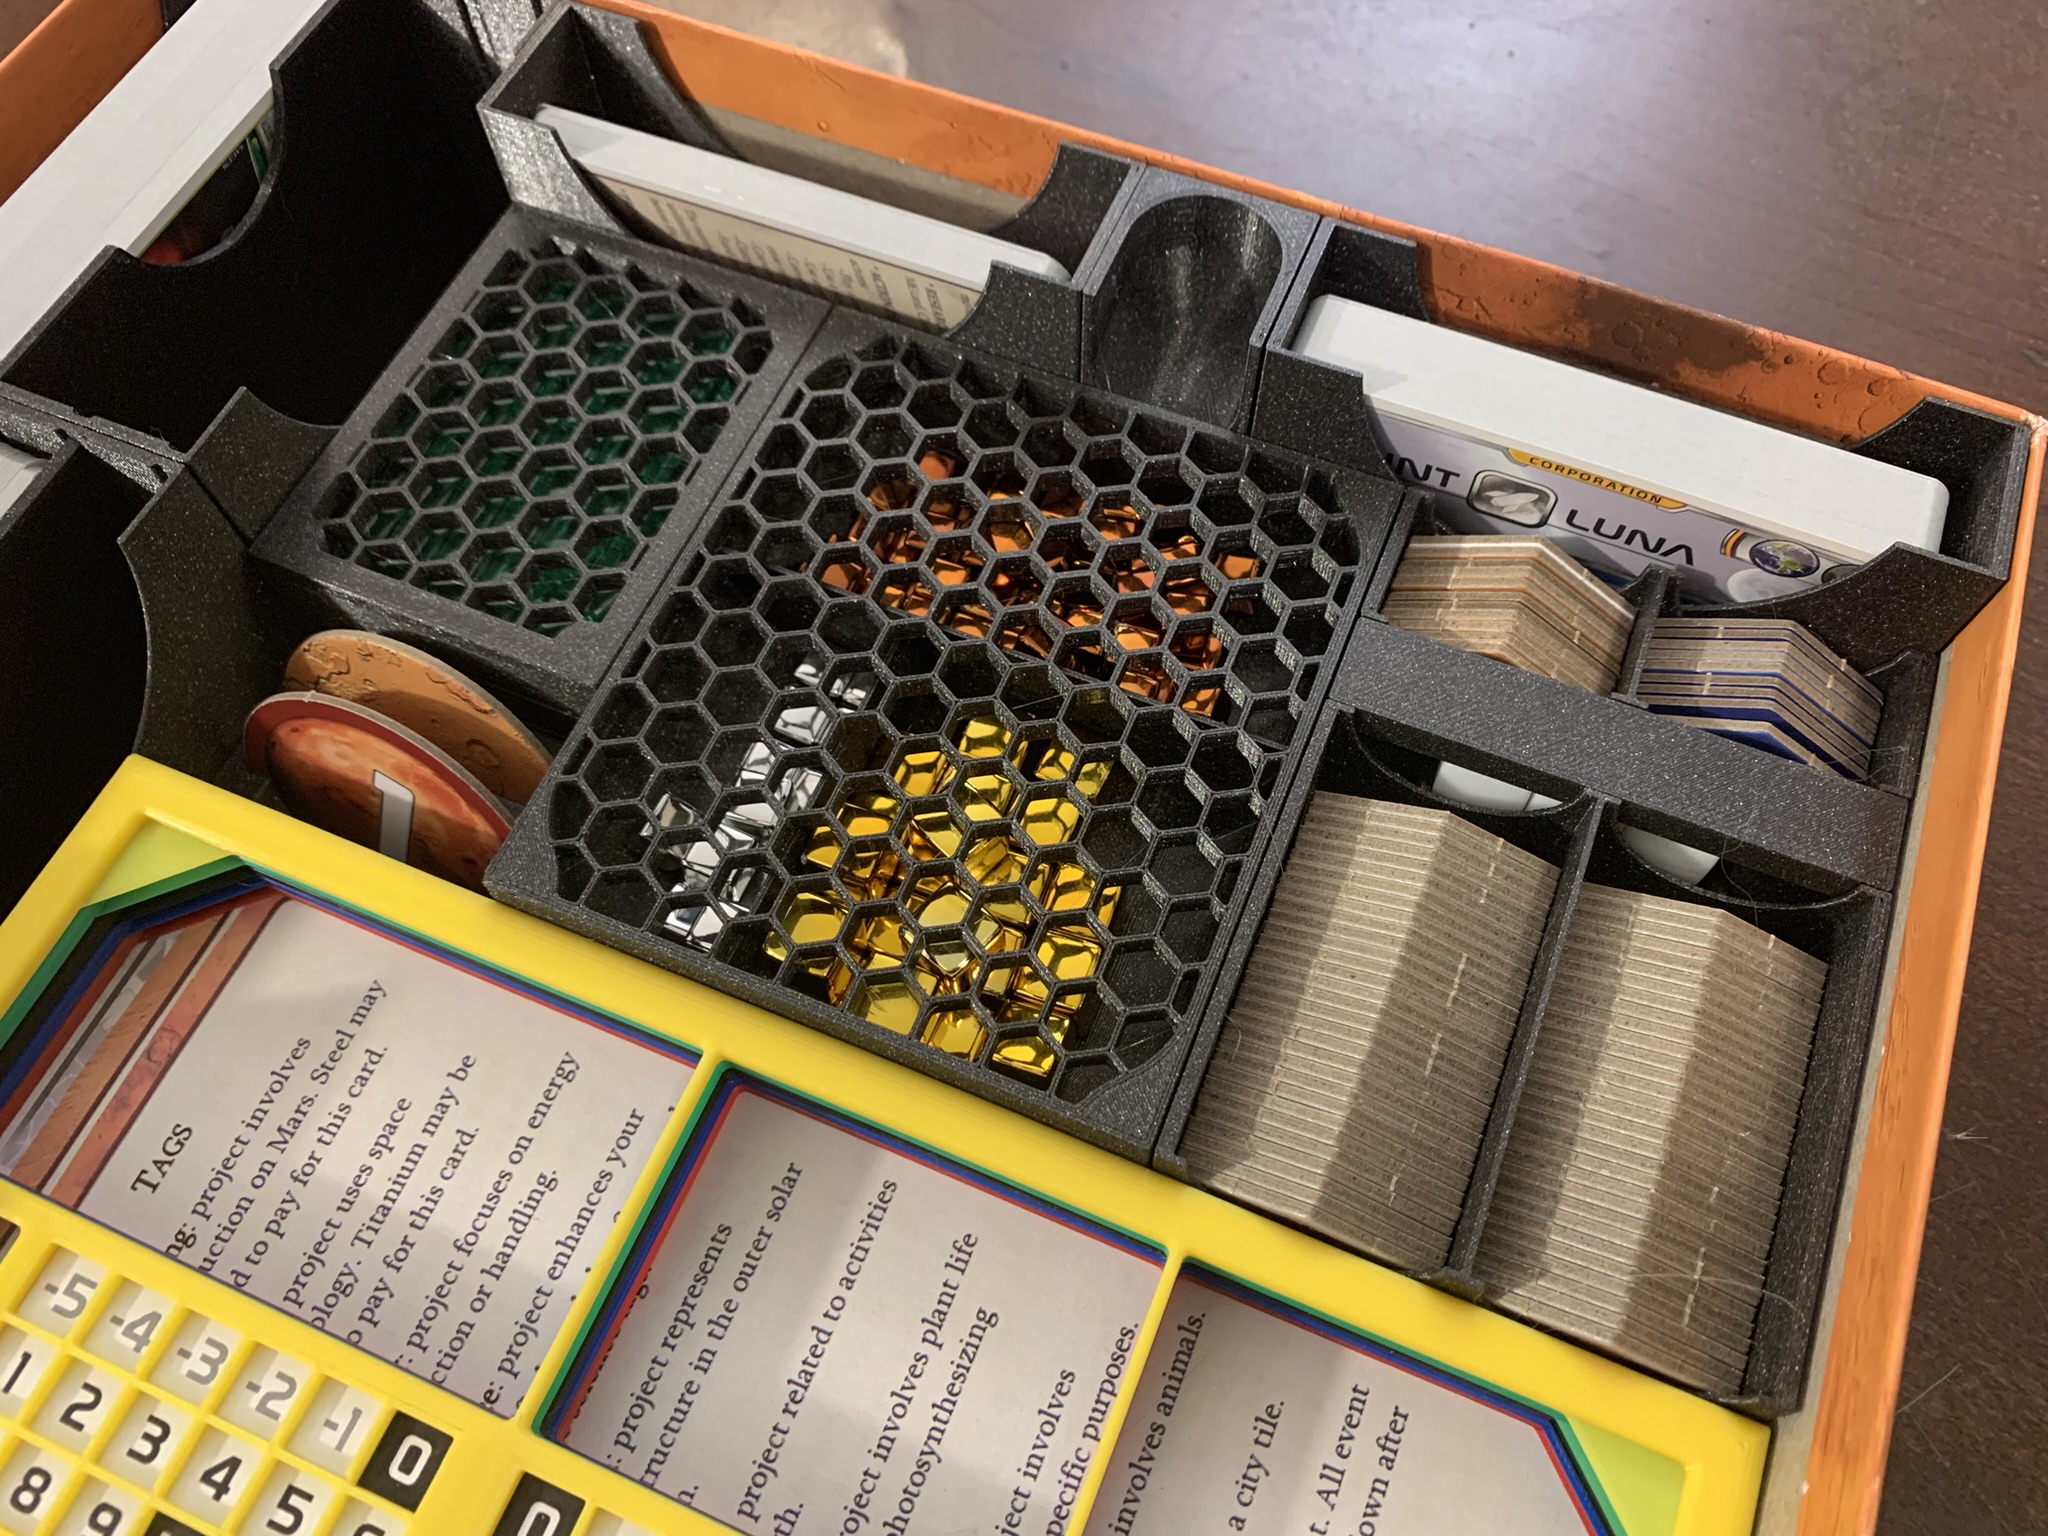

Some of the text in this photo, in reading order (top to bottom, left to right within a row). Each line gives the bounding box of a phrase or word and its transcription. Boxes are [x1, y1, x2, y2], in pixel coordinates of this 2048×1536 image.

[1529, 455, 1663, 505] CORPORATION
[1565, 508, 1694, 566] LUNA
[130, 1123, 193, 1194] TAGS
[191, 1134, 250, 1222] project
[241, 1037, 311, 1131] involves
[198, 979, 387, 1272] uction on Mars. Steel may
[230, 1047, 388, 1288] d to pay for this card.
[283, 1097, 412, 1309] project uses space
[350, 1141, 428, 1249] Titanium
[422, 1086, 460, 1137] may
[447, 1054, 477, 1082] be
[358, 1277, 395, 1328] pay
[382, 1234, 416, 1273] for
[409, 1185, 445, 1231] this
[440, 1127, 480, 1181] card.
[406, 1051, 581, 1354] project focuses on energy
[431, 1170, 559, 1385] ction or handling.
[497, 1285, 553, 1380] project
[547, 1167, 613, 1282] enhances
[606, 1108, 645, 1168] your
[613, 1222, 733, 1454] project represents
[693, 1346, 718, 1375] in
[708, 1298, 739, 1342] the
[733, 1226, 773, 1292] outer
[766, 1161, 804, 1222] solar
[2, 1351, 315, 1535] 1 2 3 4 5
[44, 1272, 433, 1486] -5 -4 -3 -2 -1 0
[736, 1178, 898, 1524] project related to activities
[840, 1232, 979, 1536] oject involves plant life
[882, 1305, 1000, 1536] hotosynthesizing
[1016, 1369, 1076, 1482] involves
[1082, 1322, 1140, 1442] purposes.
[1108, 1312, 1206, 1536] involves animals.
[1316, 1463, 1346, 1512] All
[1335, 1383, 1370, 1460] event
[10, 1466, 123, 1536] 8 9
[1228, 1400, 1285, 1532] a city tile.
[1349, 1405, 1409, 1536] own after
